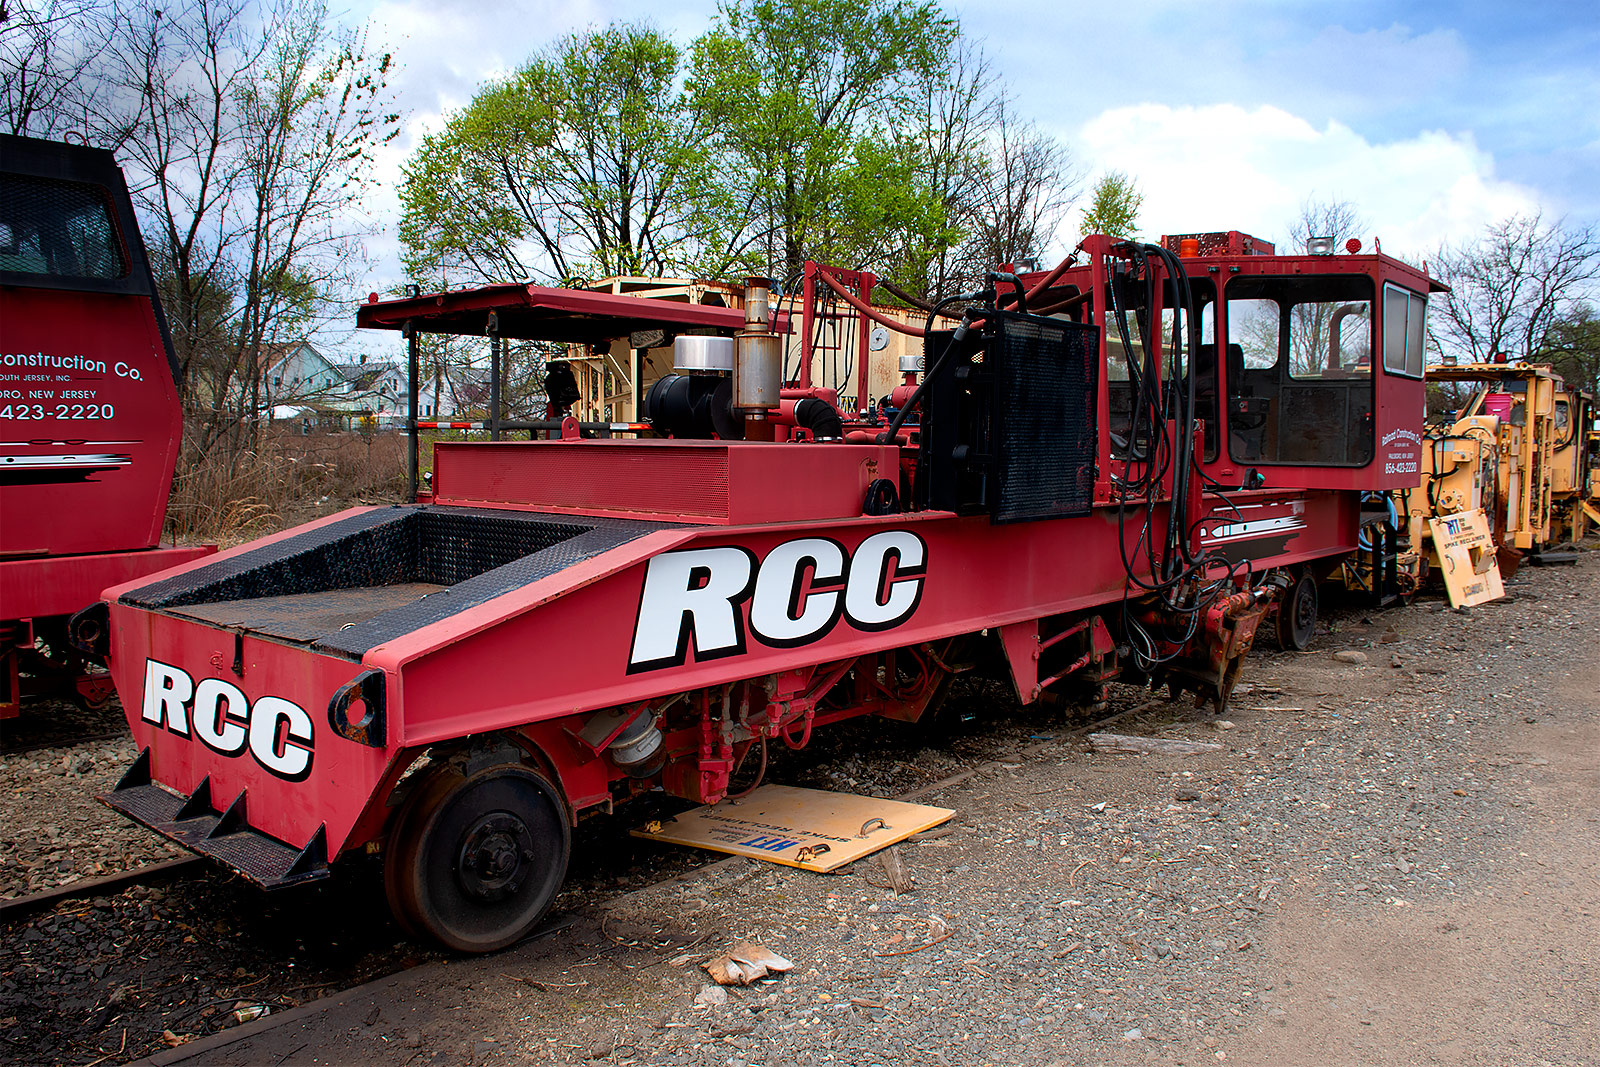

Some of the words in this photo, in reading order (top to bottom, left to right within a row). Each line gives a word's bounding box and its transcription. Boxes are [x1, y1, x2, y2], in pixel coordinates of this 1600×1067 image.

[0, 352, 107, 374] onstruction
[114, 361, 143, 381] Co.
[23, 374, 53, 382] JERSEY,
[29, 390, 54, 399] NEW
[60, 390, 97, 399] JERSEY
[0, 403, 114, 420] 423-2220
[625, 529, 928, 676] RCC
[141, 657, 315, 783] RCC
[700, 814, 793, 832] RECLAIMER
[797, 830, 852, 843] SPIKE
